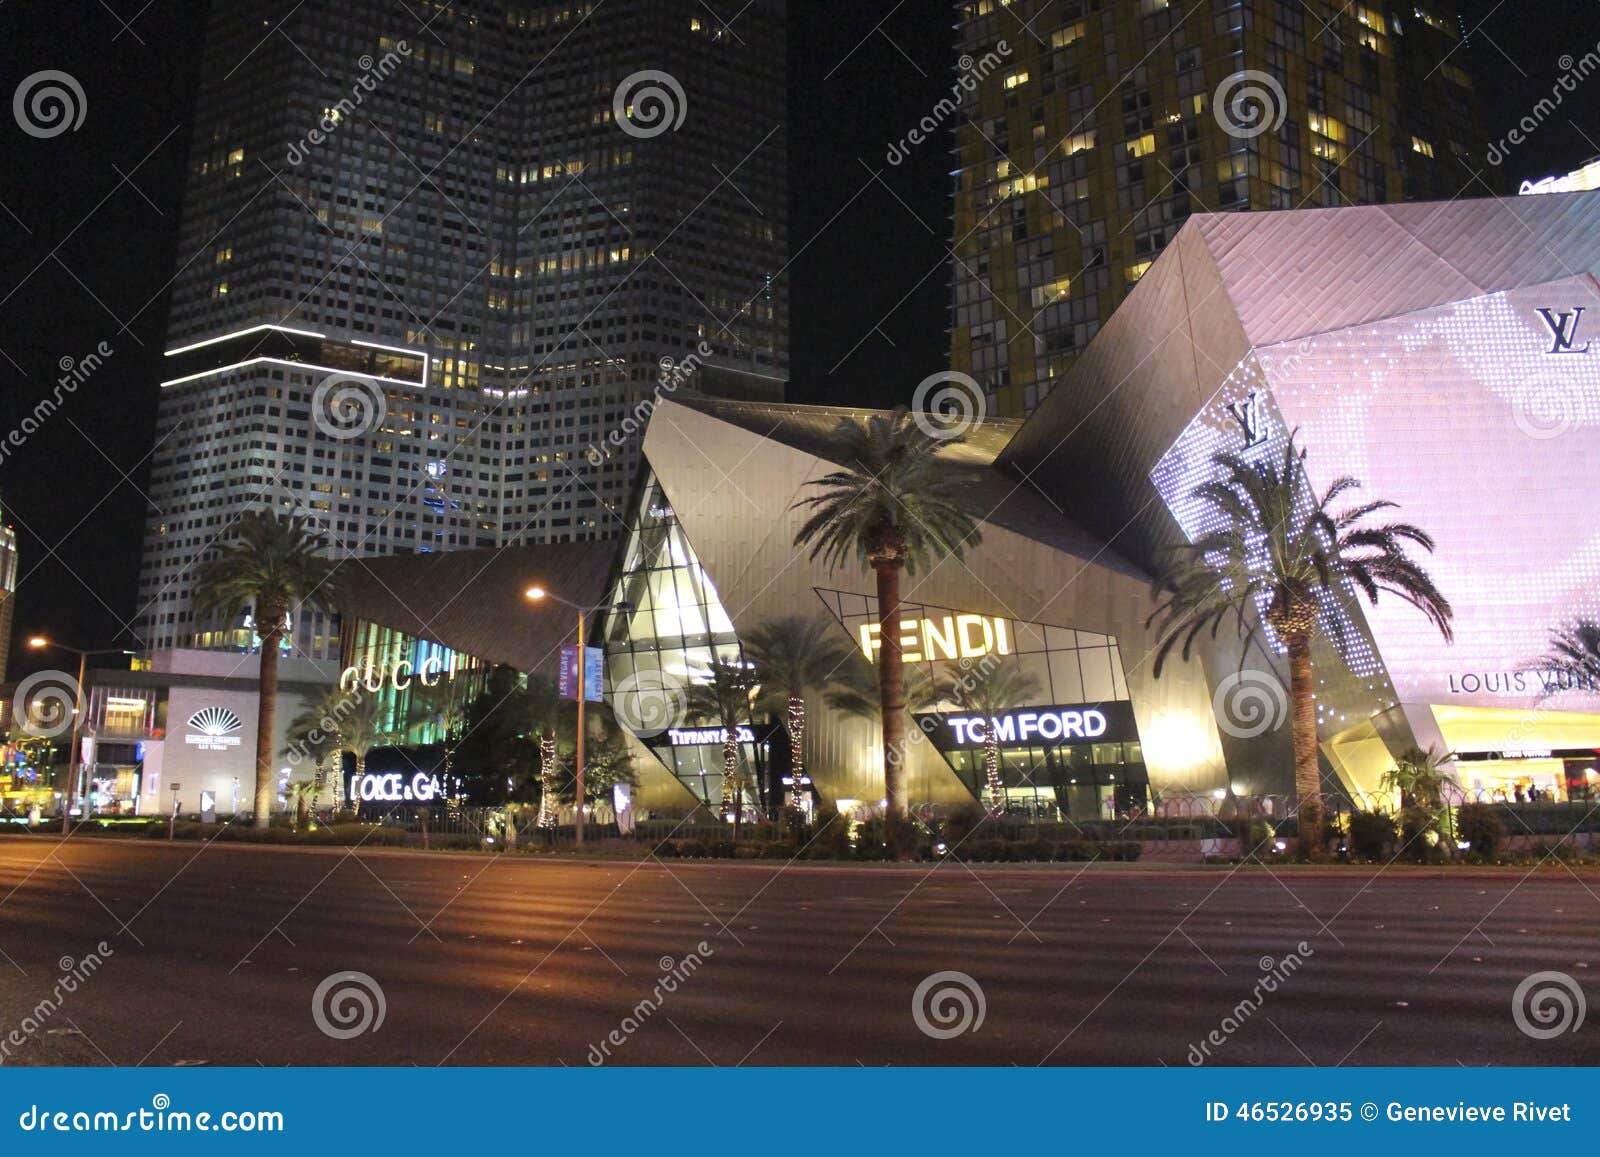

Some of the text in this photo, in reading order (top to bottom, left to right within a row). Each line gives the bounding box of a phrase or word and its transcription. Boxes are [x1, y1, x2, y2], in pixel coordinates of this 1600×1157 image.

[859, 614, 1012, 665] FENDI
[339, 655, 456, 695] GUCCI
[1449, 672, 1527, 694] LOUIS
[668, 729, 720, 745] TIFFANY
[948, 711, 1107, 744] TOM FORD
